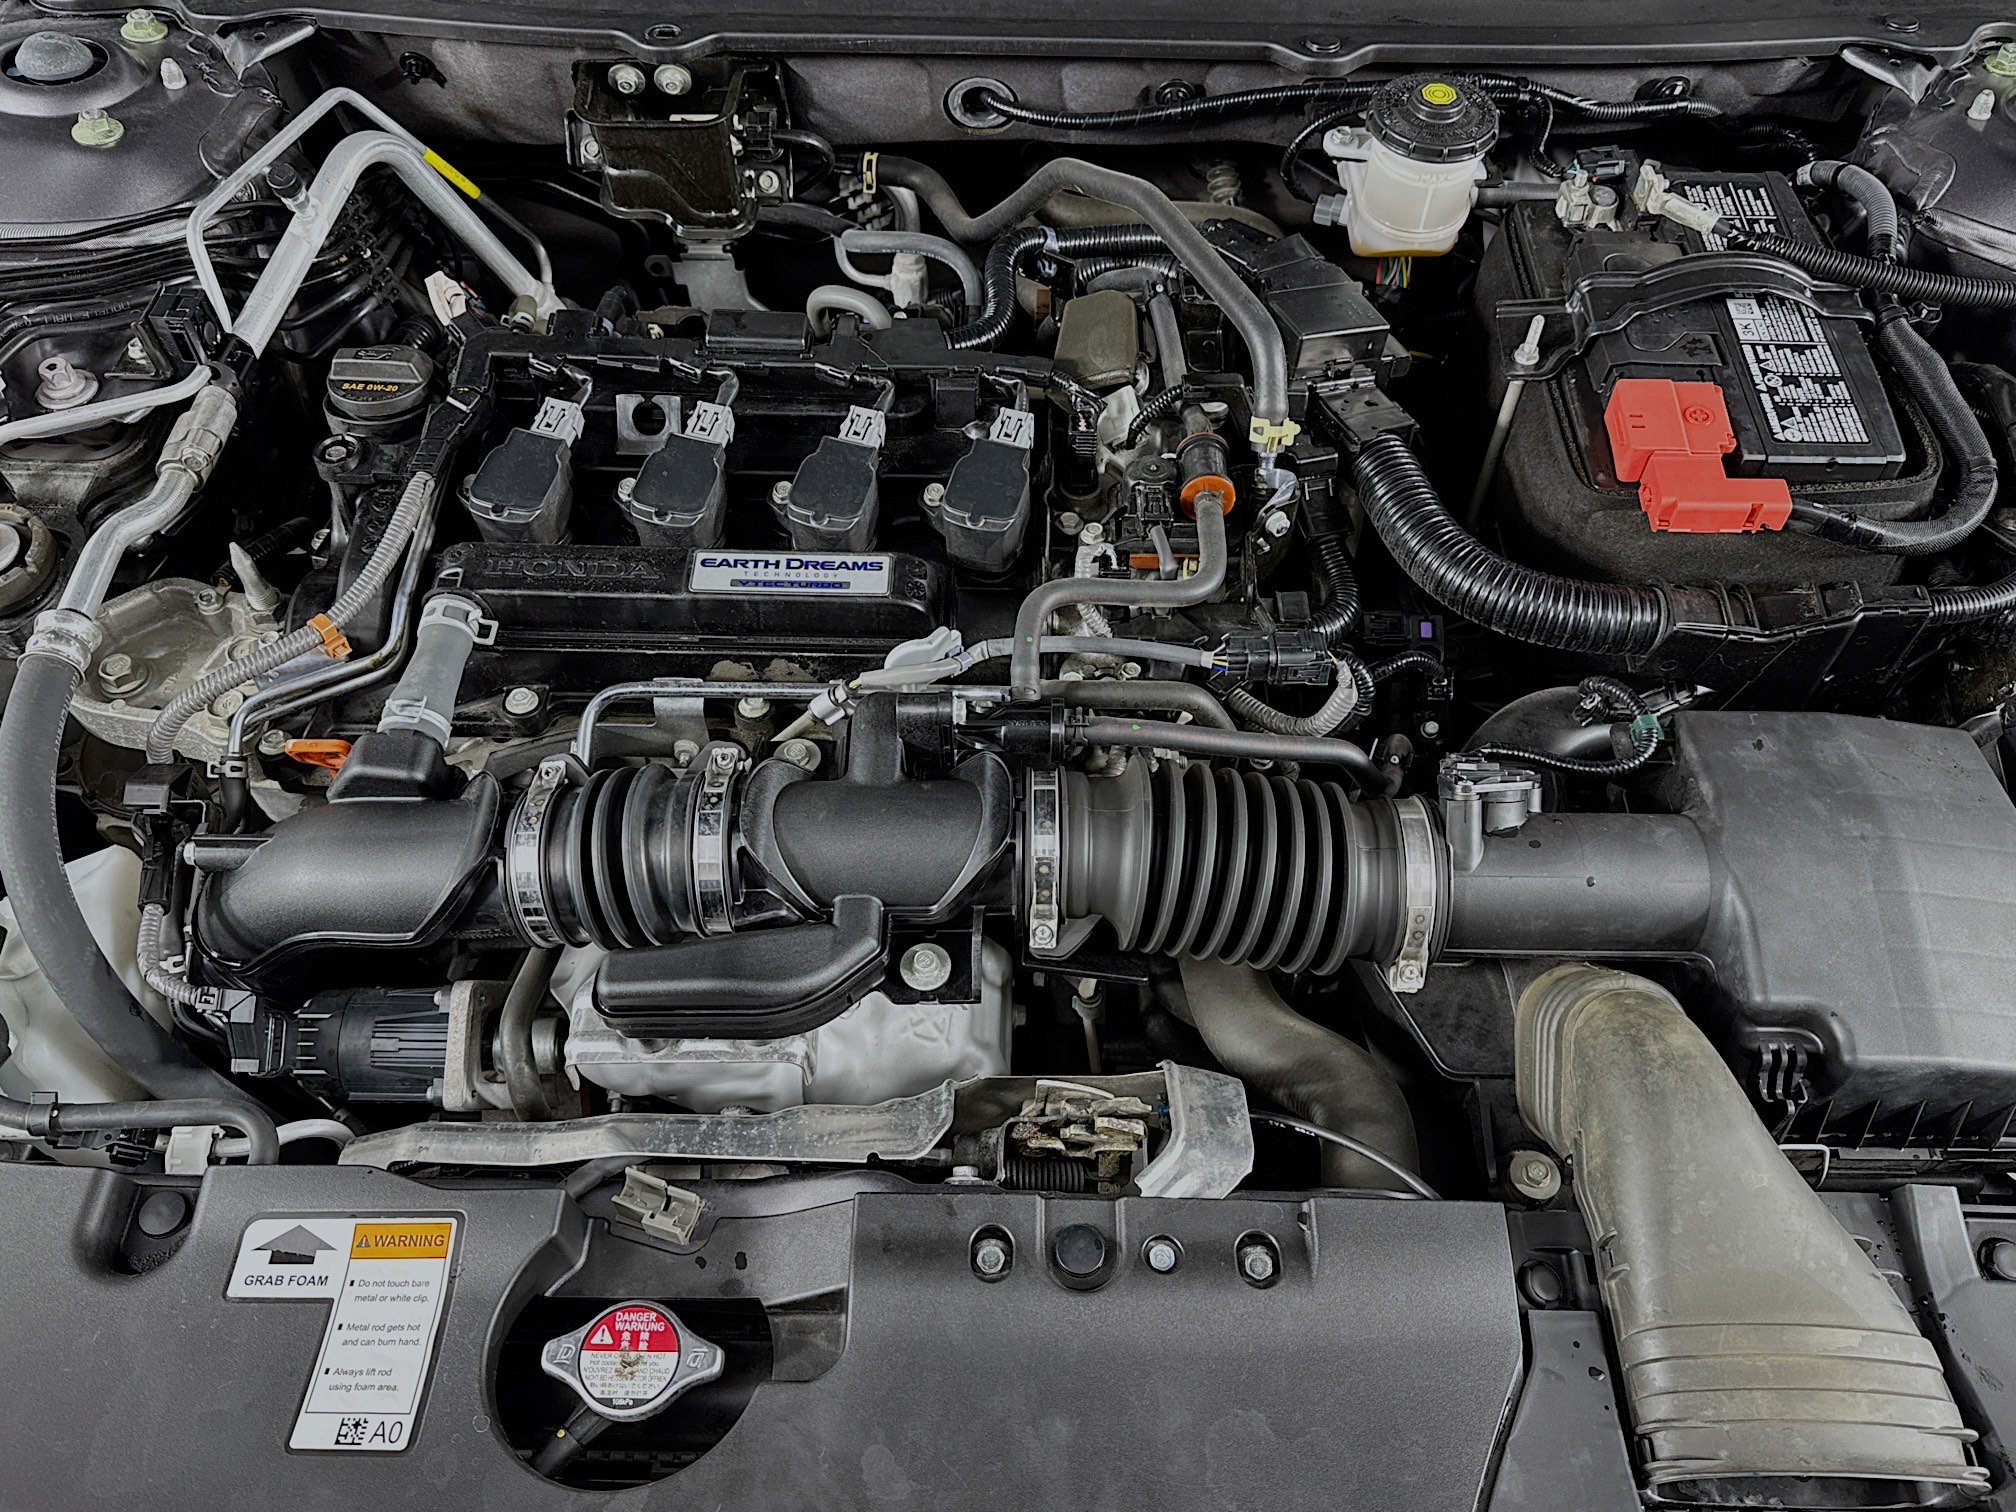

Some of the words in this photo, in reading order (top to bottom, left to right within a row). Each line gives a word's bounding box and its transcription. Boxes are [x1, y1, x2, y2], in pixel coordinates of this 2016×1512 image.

[1739, 322, 1755, 337] 3K
[341, 382, 365, 390] SAE
[484, 559, 660, 579] HONDA
[700, 557, 781, 570] EARTH
[785, 558, 884, 571] DREAMS
[743, 571, 839, 579] TECHNOLOGY
[374, 1234, 445, 1247] WARNING
[244, 1275, 284, 1287] GRAB
[287, 1275, 329, 1287] FOAM
[358, 1279, 370, 1288] Do
[372, 1279, 386, 1288] not
[386, 1279, 410, 1288] touch
[411, 1279, 430, 1288] bare
[354, 1294, 378, 1303] metal
[389, 1294, 412, 1303] white
[413, 1294, 430, 1304] clip.
[616, 1312, 657, 1322] DANGER
[346, 1323, 370, 1332] Metal
[371, 1323, 386, 1332] rod
[387, 1324, 405, 1333] gets
[407, 1323, 420, 1332] hot
[615, 1322, 665, 1332] WARNUNG
[342, 1338, 359, 1346] and
[378, 1338, 396, 1346] burn
[398, 1338, 422, 1346] hand.
[333, 1368, 364, 1378] Always
[366, 1368, 376, 1377] lift
[378, 1368, 392, 1377] rod
[328, 1384, 352, 1392] using
[354, 1383, 376, 1391] foam
[378, 1384, 400, 1392] area.
